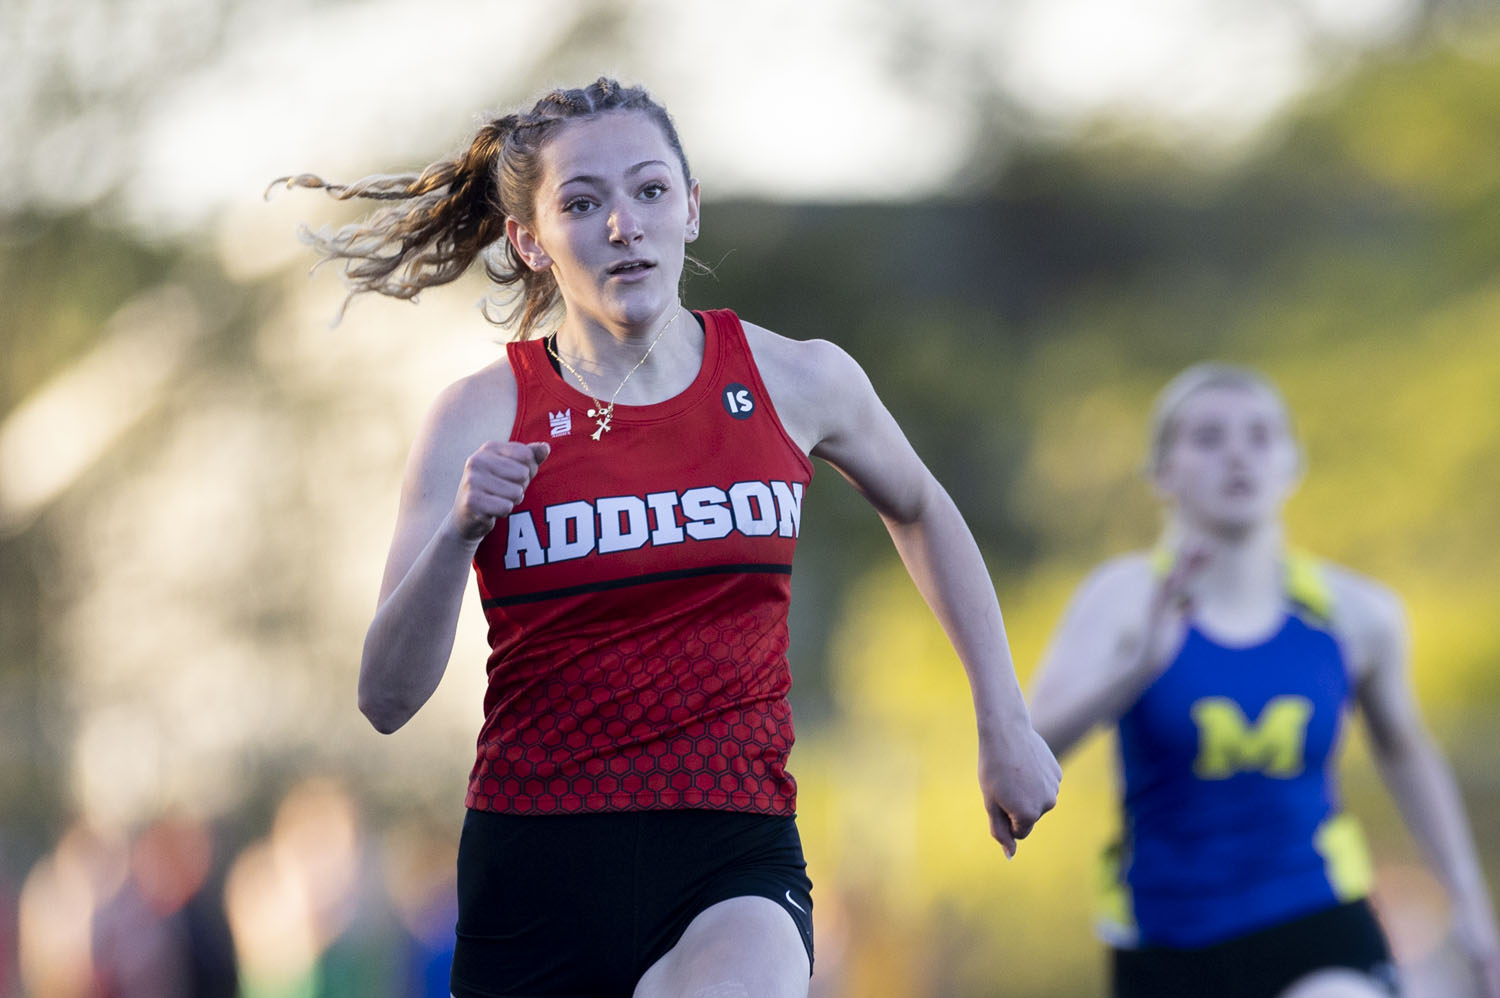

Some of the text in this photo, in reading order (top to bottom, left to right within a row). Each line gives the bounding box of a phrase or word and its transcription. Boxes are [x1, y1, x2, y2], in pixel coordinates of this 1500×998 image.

[726, 390, 753, 413] IS
[504, 480, 803, 569] ADDISON
[1192, 696, 1313, 780] M
